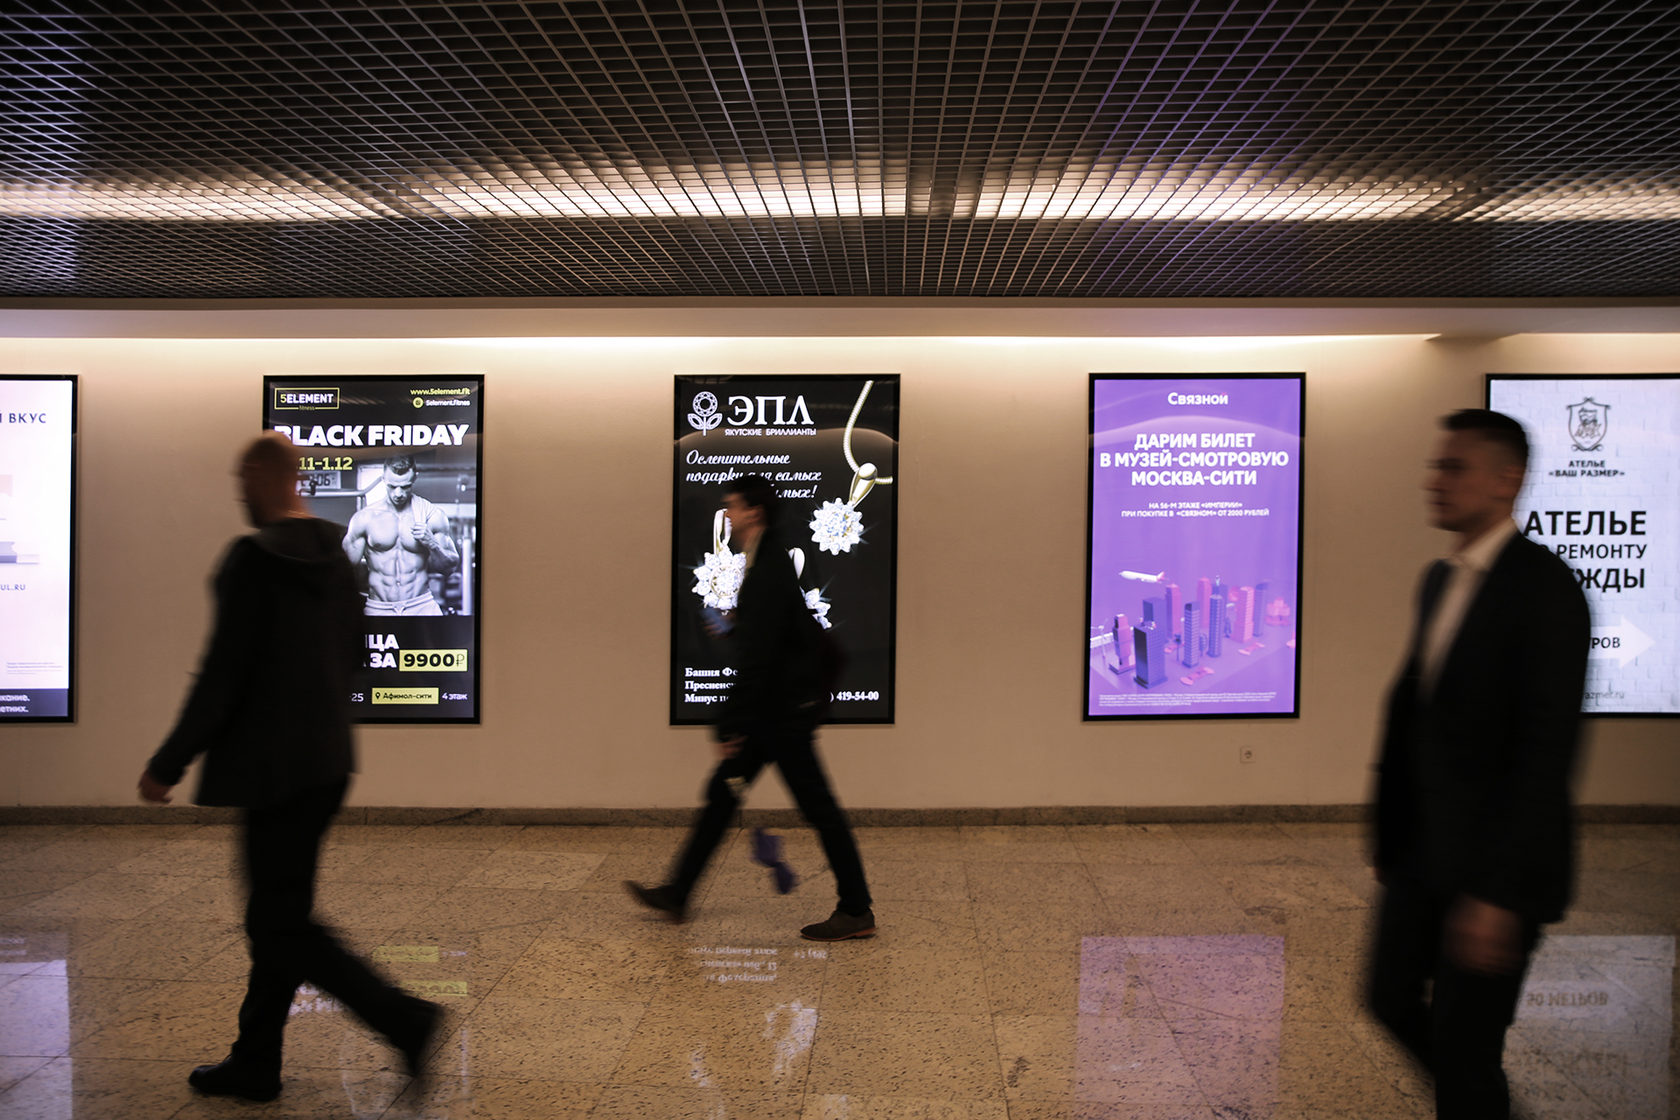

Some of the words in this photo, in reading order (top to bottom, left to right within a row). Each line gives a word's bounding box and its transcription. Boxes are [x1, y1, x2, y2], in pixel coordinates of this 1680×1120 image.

[280, 393, 334, 404] 5ELEMENT
[1167, 391, 1229, 405] Связной
[727, 395, 815, 426] ЭПЛ
[9, 412, 46, 424] ВКУС
[368, 424, 470, 446] FRIDAY
[724, 428, 762, 436] ЯКУТСКИЕ
[765, 428, 817, 436] БРИЛЛИАНТЫ
[1134, 433, 1197, 451] ДАРИМ
[1200, 432, 1256, 448] БИЛЕТ
[299, 456, 353, 470] 11-1.12
[686, 449, 791, 465] Ослепительные
[1100, 452, 1111, 467] В
[1114, 449, 1289, 468] МУЗЕЙ-СМОТРОВУЮ
[1568, 460, 1606, 468] АТЕЛЬЕ
[775, 471, 822, 481] самых
[1131, 470, 1257, 486] МОСКВА-СИТИ
[1548, 469, 1577, 477] «ВАШ
[1580, 469, 1625, 477] РАЗМЕР»
[775, 484, 818, 498] мых!
[1176, 509, 1217, 517] «СВЯЗНОМ»
[1217, 509, 1227, 517] ОТ
[1227, 509, 1243, 517] 2000
[1244, 508, 1270, 517] РУБЛЕЙ
[1523, 510, 1647, 536] АТЕЛЬЕ
[1557, 544, 1647, 559] РЕМОНТУ
[1575, 568, 1645, 593] ЖДЫ
[1591, 636, 1621, 649] РОВ
[684, 667, 720, 677] Башня
[684, 693, 718, 705] Минус
[836, 690, 880, 701] 419-54-00
